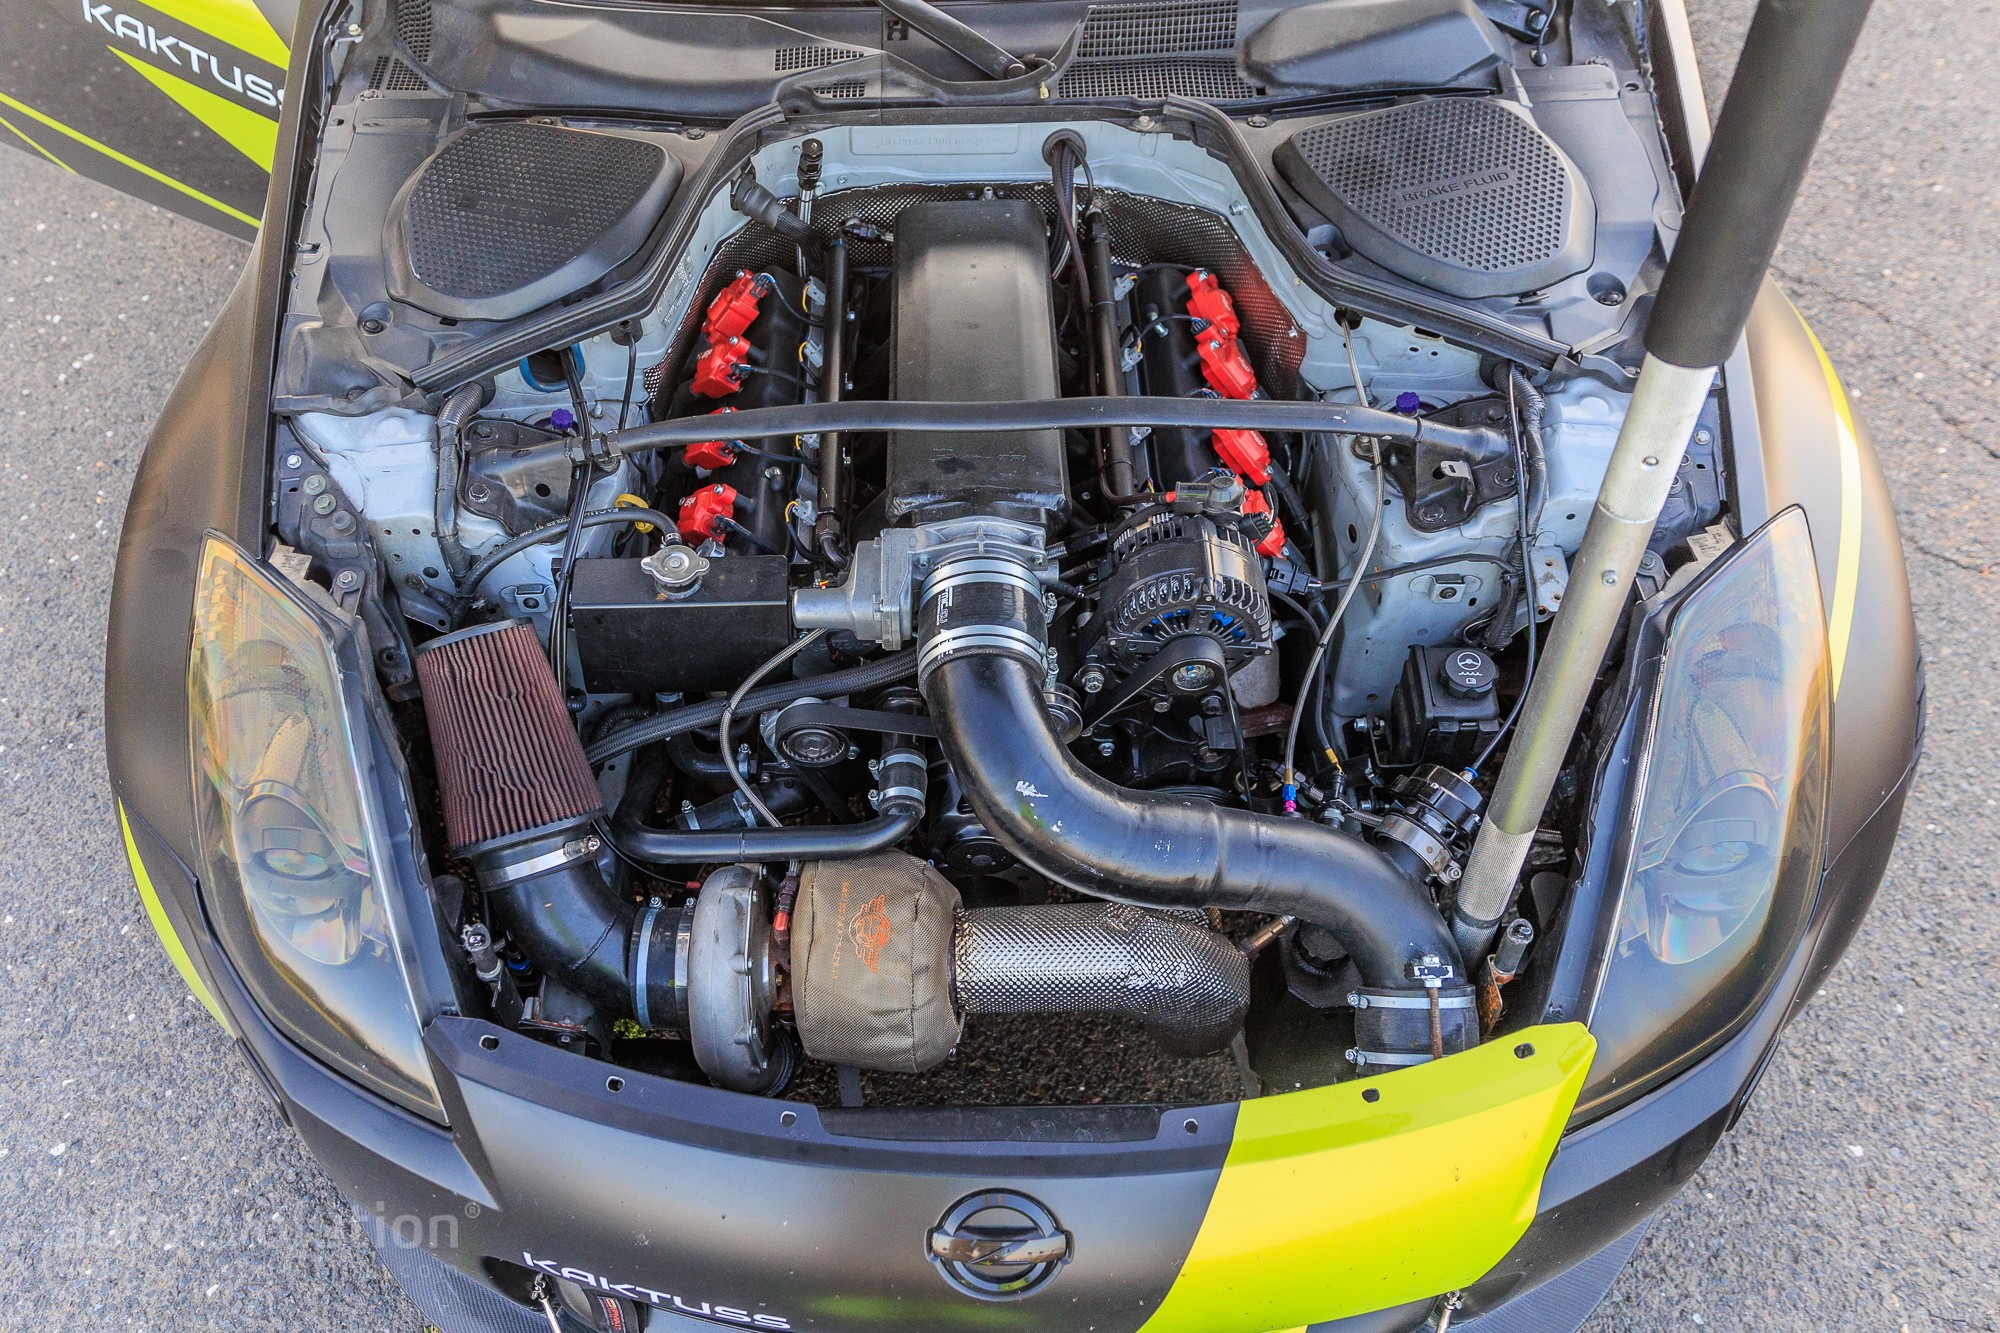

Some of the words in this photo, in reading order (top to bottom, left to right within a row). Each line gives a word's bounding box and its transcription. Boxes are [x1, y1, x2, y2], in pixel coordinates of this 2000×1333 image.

[82, 0, 285, 110] KAKTUS
[1402, 181, 1461, 202] BRAKE
[1463, 171, 1511, 190] FLUID
[522, 1251, 791, 1330] KAKTUSS
